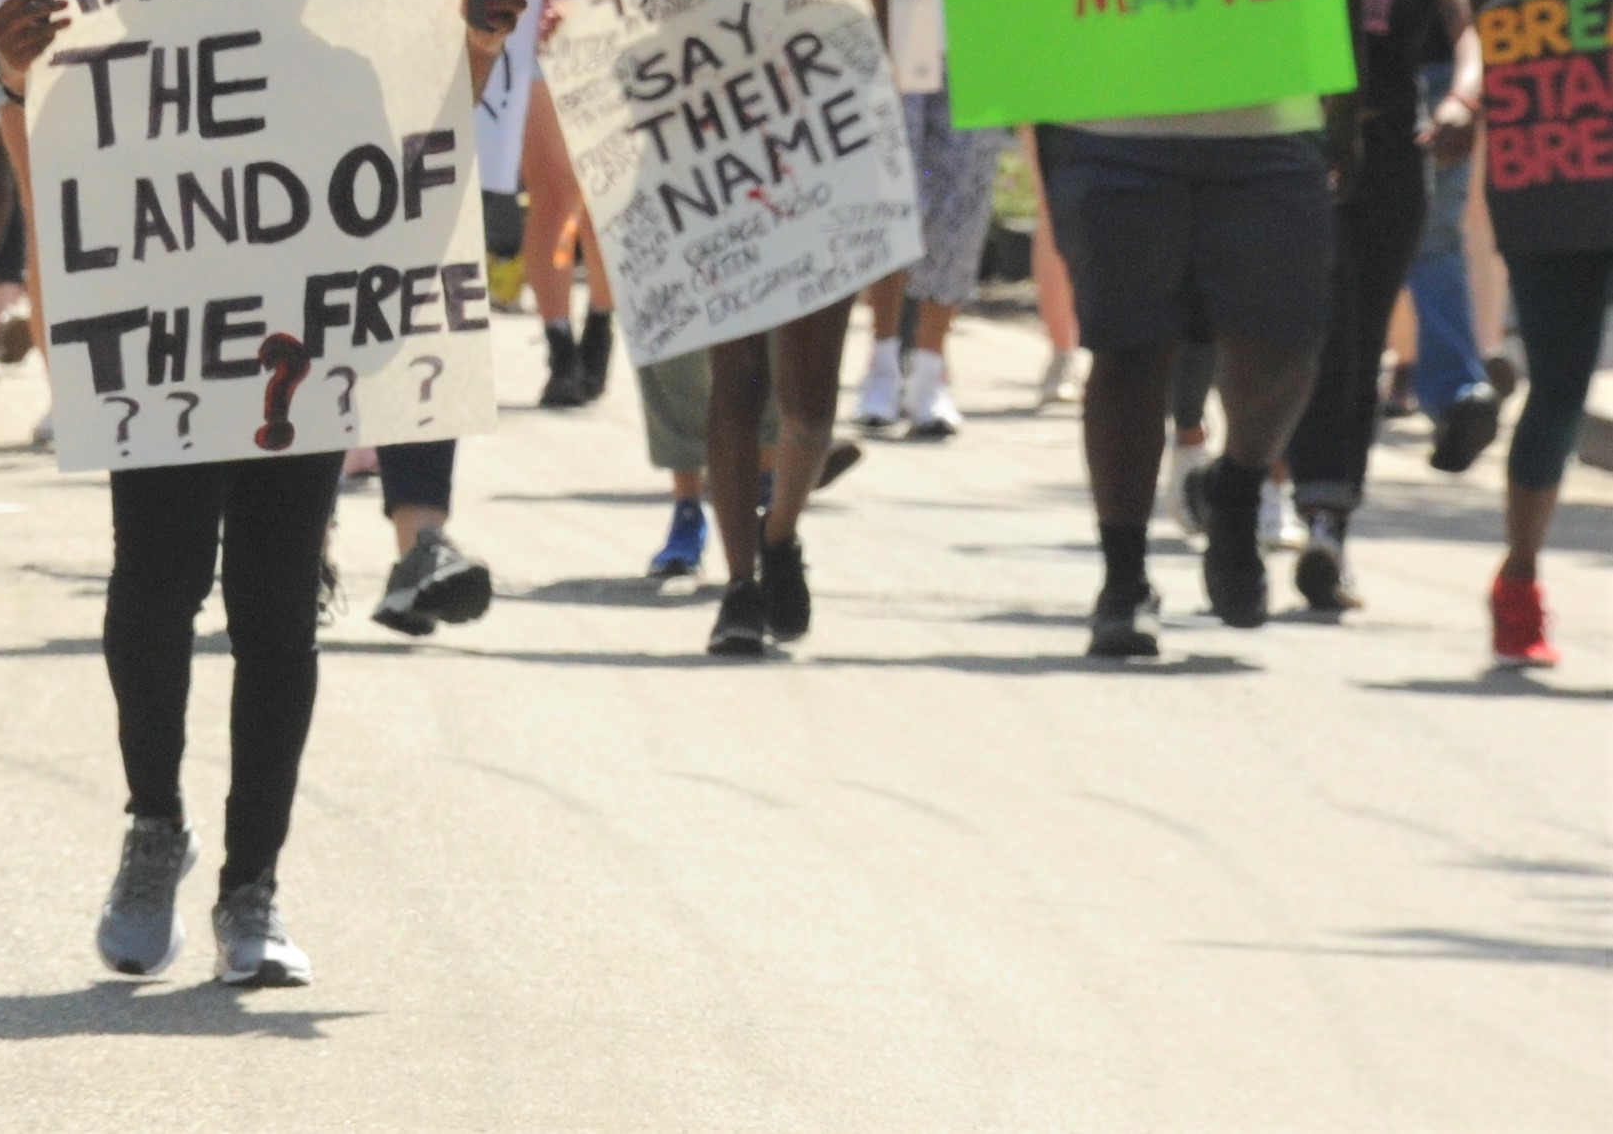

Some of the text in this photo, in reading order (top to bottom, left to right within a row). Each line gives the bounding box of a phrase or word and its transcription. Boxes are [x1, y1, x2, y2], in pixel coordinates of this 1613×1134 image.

[51, 30, 268, 149] THE
[625, 1, 756, 103] SAY
[631, 31, 842, 162] THEIR
[1485, 54, 1613, 123] STA
[61, 160, 311, 273] LAND
[327, 129, 458, 240] OF
[657, 89, 875, 234] NAME
[50, 262, 489, 394] THE FREE
